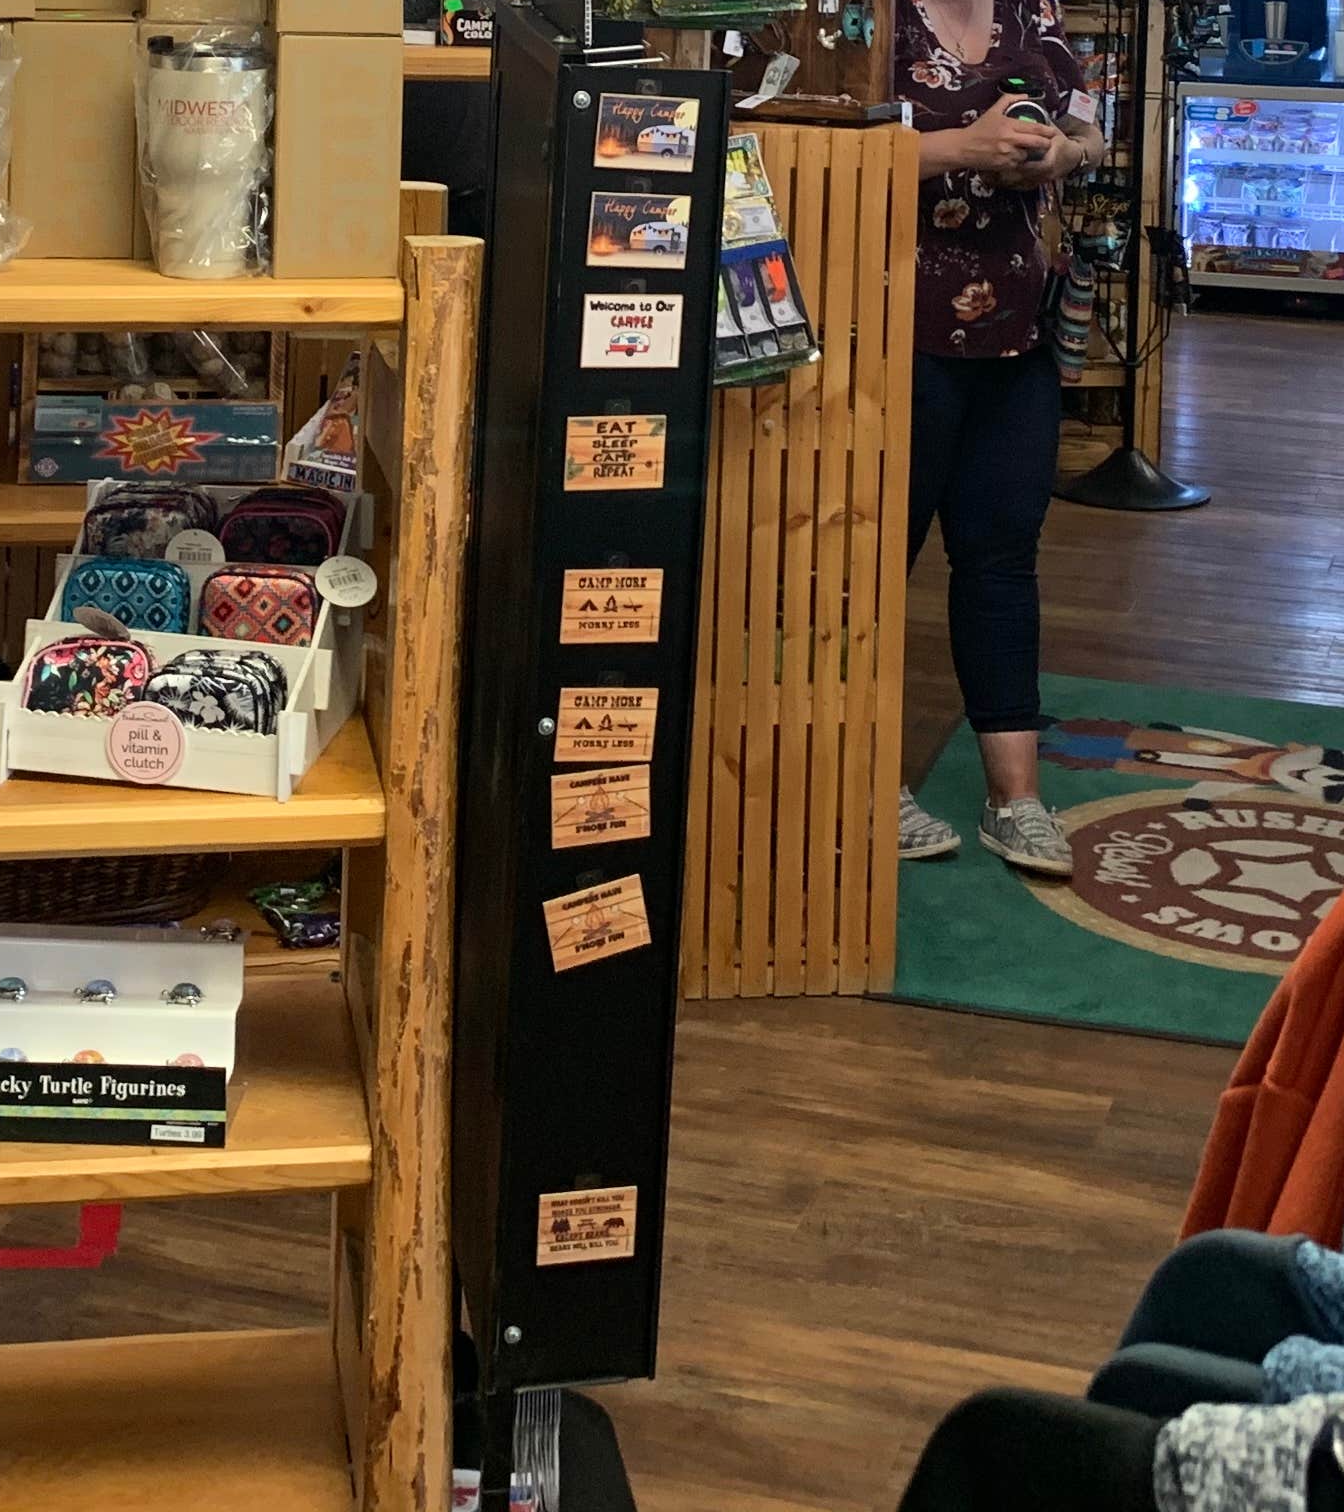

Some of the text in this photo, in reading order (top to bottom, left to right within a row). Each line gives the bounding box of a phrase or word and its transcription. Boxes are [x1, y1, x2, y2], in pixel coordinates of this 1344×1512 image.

[611, 101, 686, 124] Happy Camper
[604, 198, 678, 221] Happy Camper
[590, 300, 676, 312] Welcome to Our
[596, 421, 637, 434] EAT
[592, 439, 638, 449] SLEEP
[593, 453, 636, 463] CAMP
[294, 465, 336, 487] MAGIC
[339, 473, 355, 492] IN
[593, 466, 635, 478] REPEAT
[578, 577, 647, 589] CAMP MORE
[578, 620, 640, 630] WORRY LESS
[574, 695, 643, 708] CAMP MORE
[128, 728, 162, 743] pill &
[121, 741, 168, 756] vitamin
[573, 739, 634, 749] WORRY LESS
[124, 756, 164, 769] clutch
[569, 773, 631, 789] CAMPERS HAVE
[575, 821, 607, 834] S'MORE
[562, 887, 623, 911] CAMPERS HAVE
[39, 1074, 93, 1096] Turtle
[99, 1074, 186, 1101] Figurines
